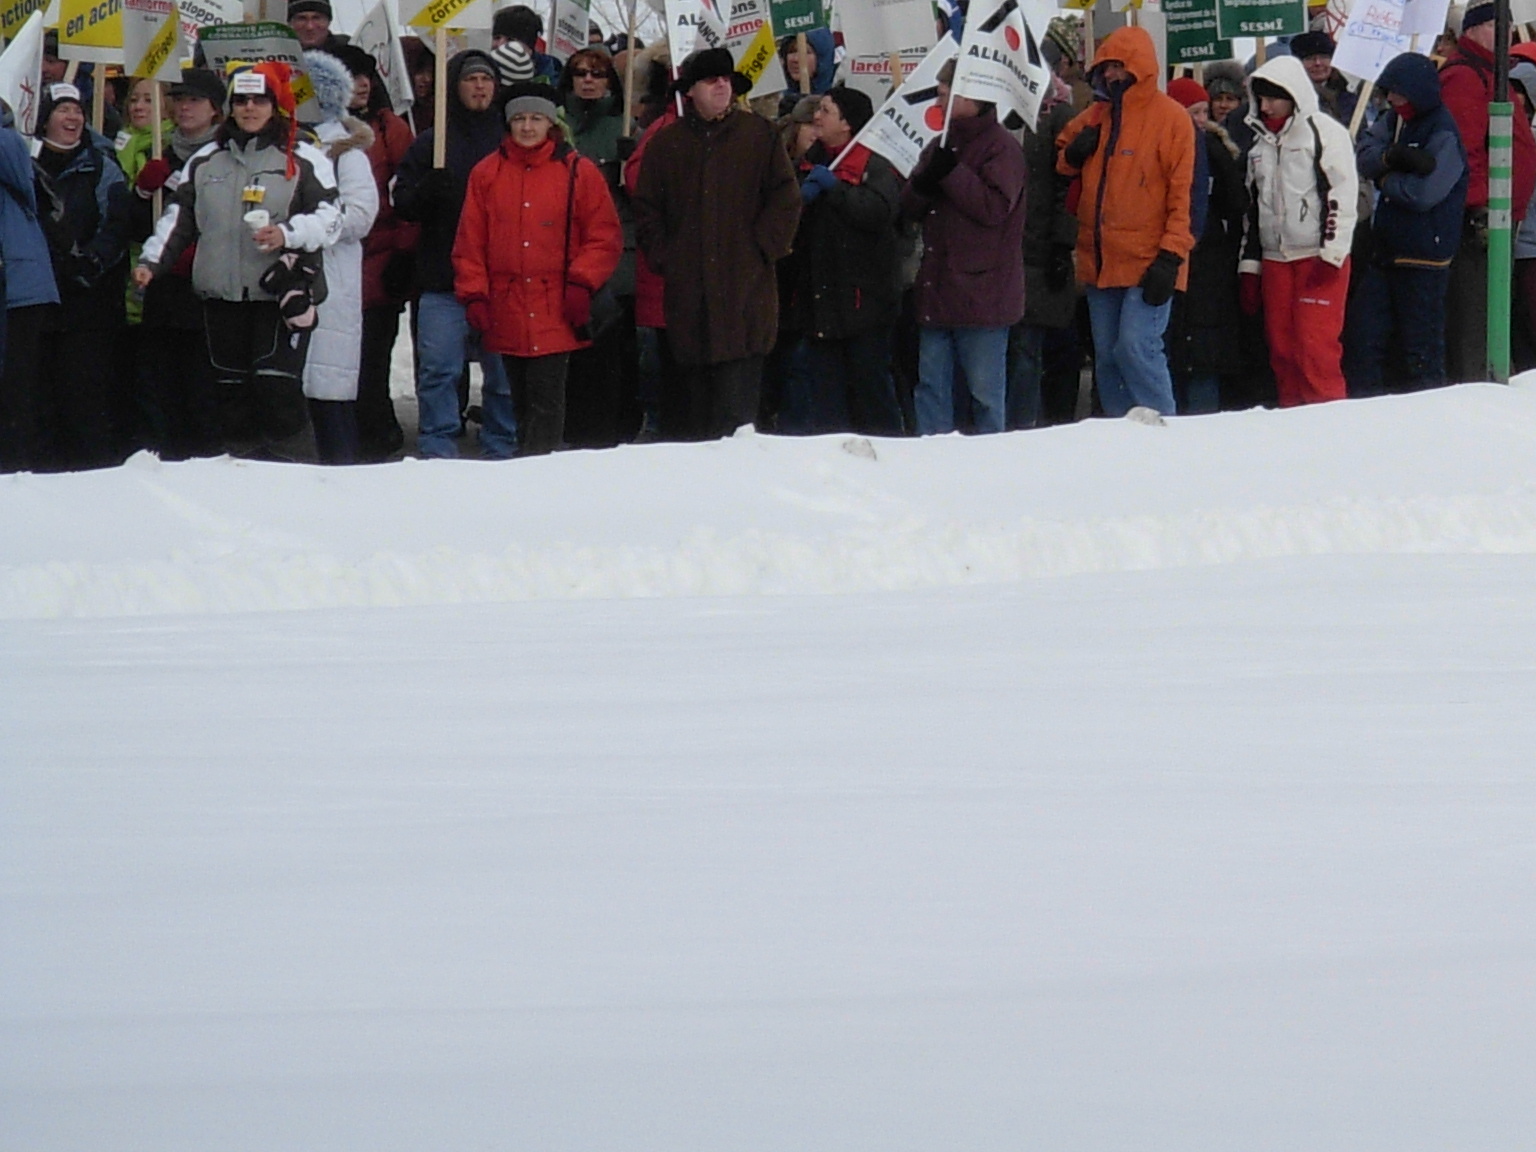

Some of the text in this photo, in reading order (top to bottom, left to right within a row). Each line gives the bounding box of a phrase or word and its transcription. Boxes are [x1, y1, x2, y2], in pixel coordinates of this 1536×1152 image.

[66, 14, 84, 38] en
[180, 0, 224, 25] stoppo
[968, 44, 1040, 95] ALLIANCE
[884, 107, 925, 149] ALLIA
